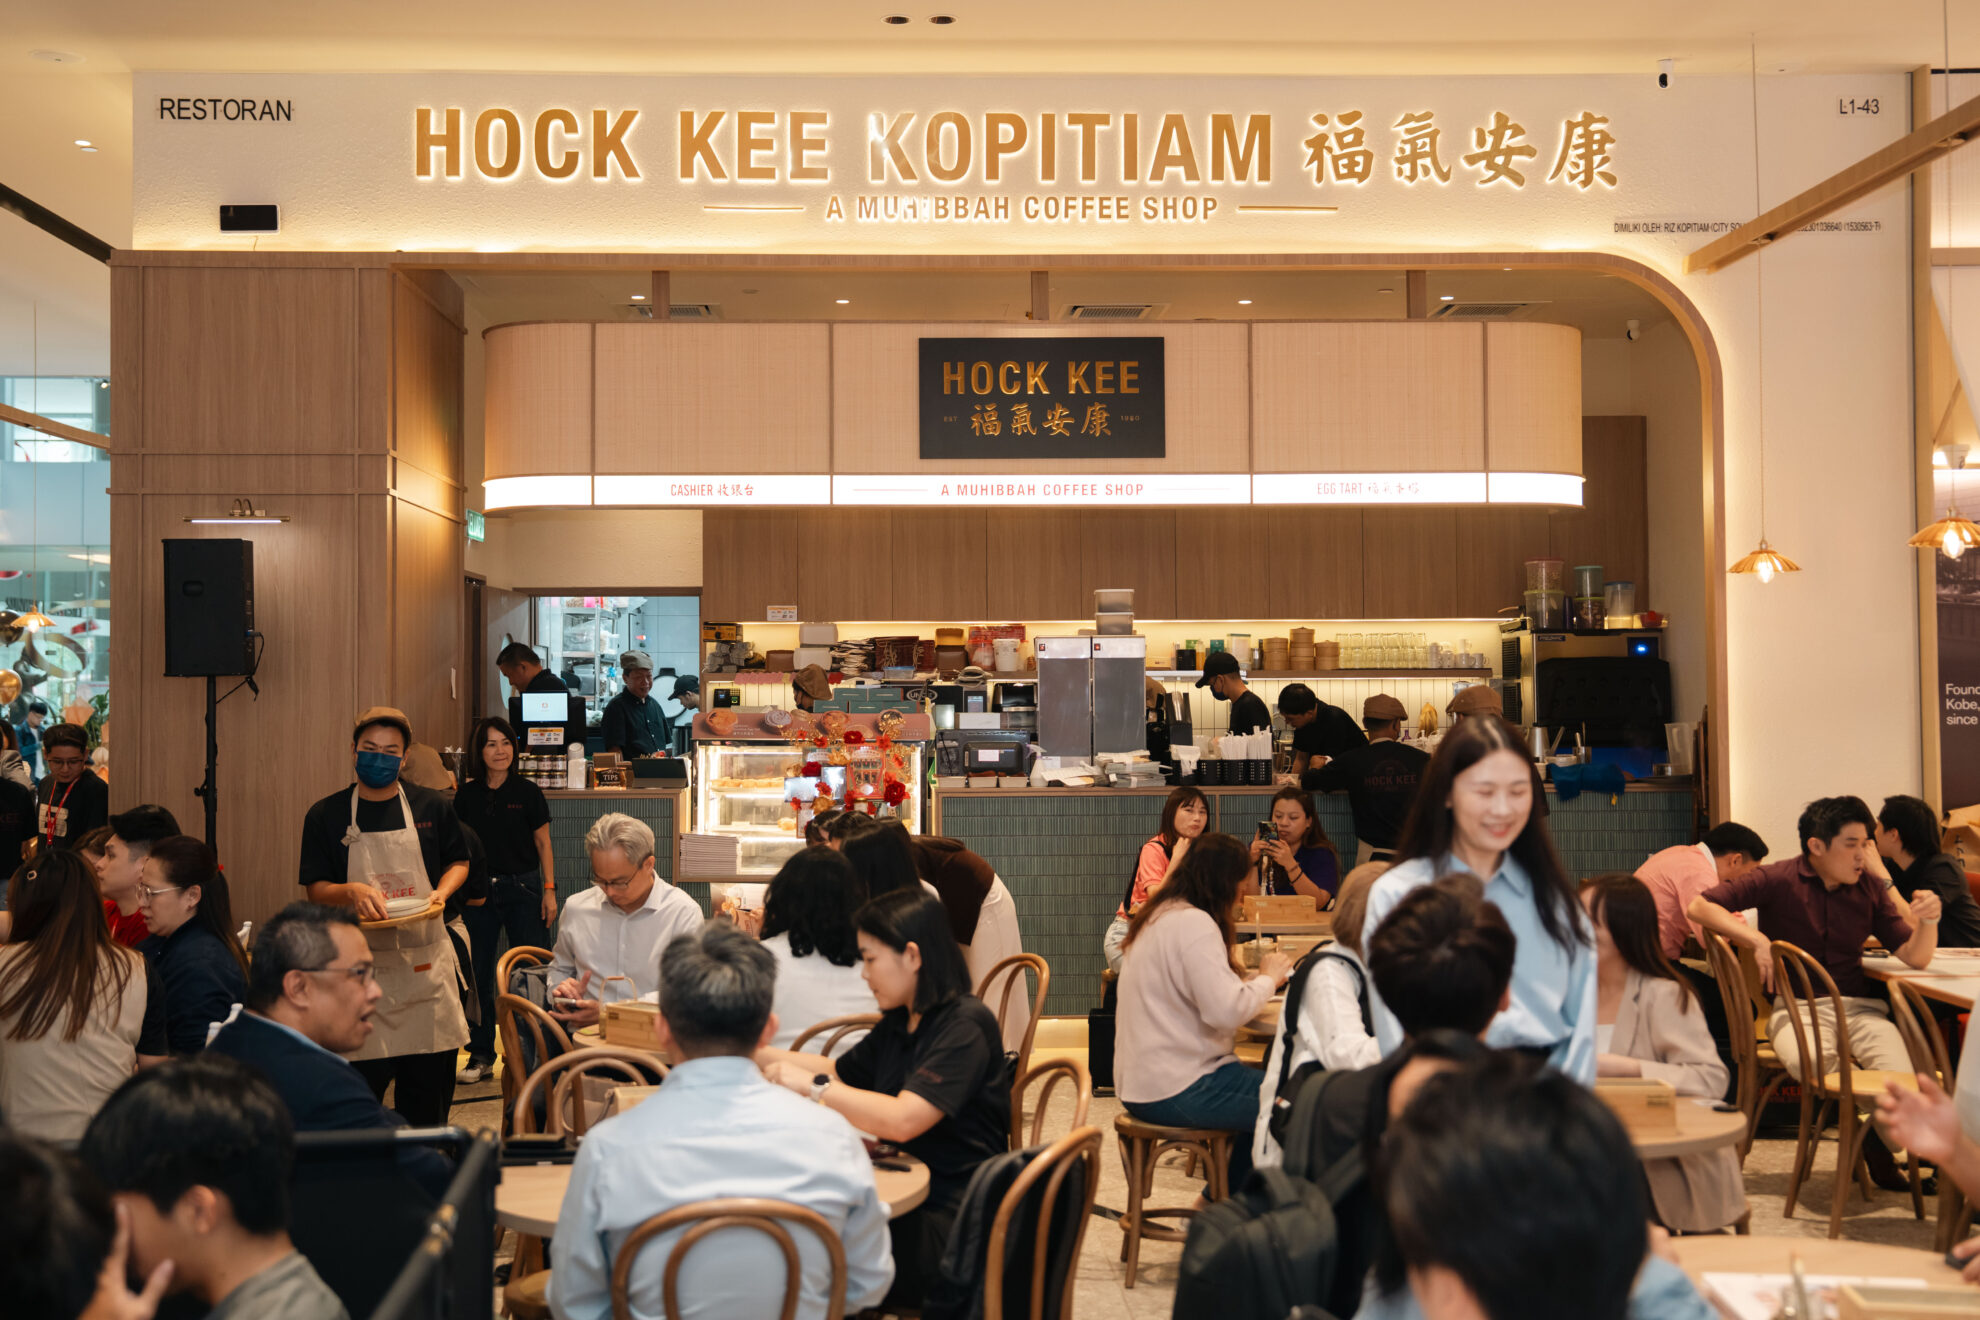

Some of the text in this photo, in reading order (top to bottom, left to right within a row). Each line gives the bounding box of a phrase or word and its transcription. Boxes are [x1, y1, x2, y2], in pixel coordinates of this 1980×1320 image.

[160, 98, 291, 121] RESTORAN
[1839, 98, 1880, 115] L1-43
[416, 108, 1271, 182] HOCK KEE KOPITIAM
[1303, 110, 1618, 189] 福氣安康
[826, 196, 843, 219] A
[1024, 196, 1130, 219] COFFEE
[1143, 196, 1218, 220] SHOP
[1614, 222, 1641, 233] DIMILIKI
[1677, 222, 1709, 233] KOPITIAM
[1711, 222, 1729, 233] (CITY
[943, 361, 1139, 395] HOCK KEE
[970, 402, 1111, 437] 福氣安康
[671, 484, 713, 496] CASHIER
[941, 484, 1144, 496] A MUHIBBAH COFFEE SHOP
[1317, 483, 1336, 495] EGG
[1340, 483, 1363, 495] TART
[1946, 713, 1978, 725] since
[392, 887, 416, 898] KEE
